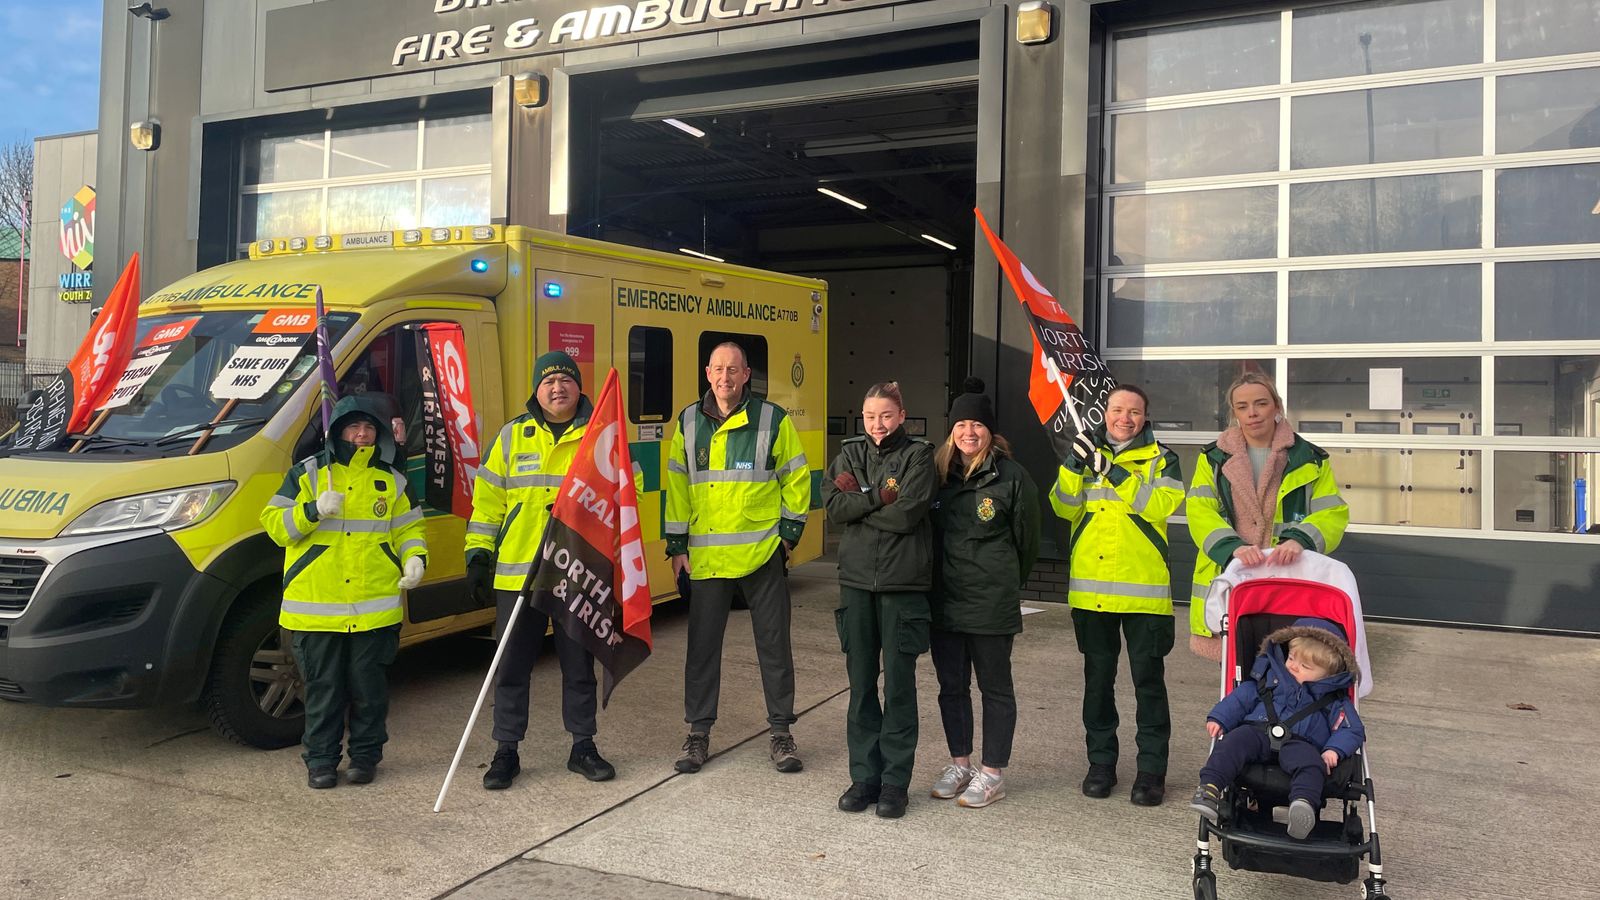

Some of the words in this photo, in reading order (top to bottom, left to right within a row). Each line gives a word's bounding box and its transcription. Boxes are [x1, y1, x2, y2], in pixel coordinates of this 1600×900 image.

[391, 24, 494, 66] FIRE
[503, 18, 542, 49] &
[549, 0, 858, 44] AMBUL
[345, 235, 388, 245] AMBULANCE
[59, 273, 92, 288] WIRR
[58, 291, 84, 302] YOUTH
[179, 283, 317, 302] AMBULANCE
[617, 286, 703, 314] EMERGENCY
[706, 297, 776, 322] AMBULANCE
[777, 308, 799, 322] A770B
[272, 314, 312, 327] GMB
[153, 325, 185, 341] GMB
[565, 346, 580, 357] 999
[228, 357, 262, 370] SAVE
[260, 358, 290, 370] OUR
[121, 364, 159, 382] FFICIAL
[230, 374, 261, 387] NHS
[423, 391, 435, 454] IRISH
[434, 427, 447, 489] WEST
[735, 461, 753, 470] NHS
[552, 578, 568, 602] &
